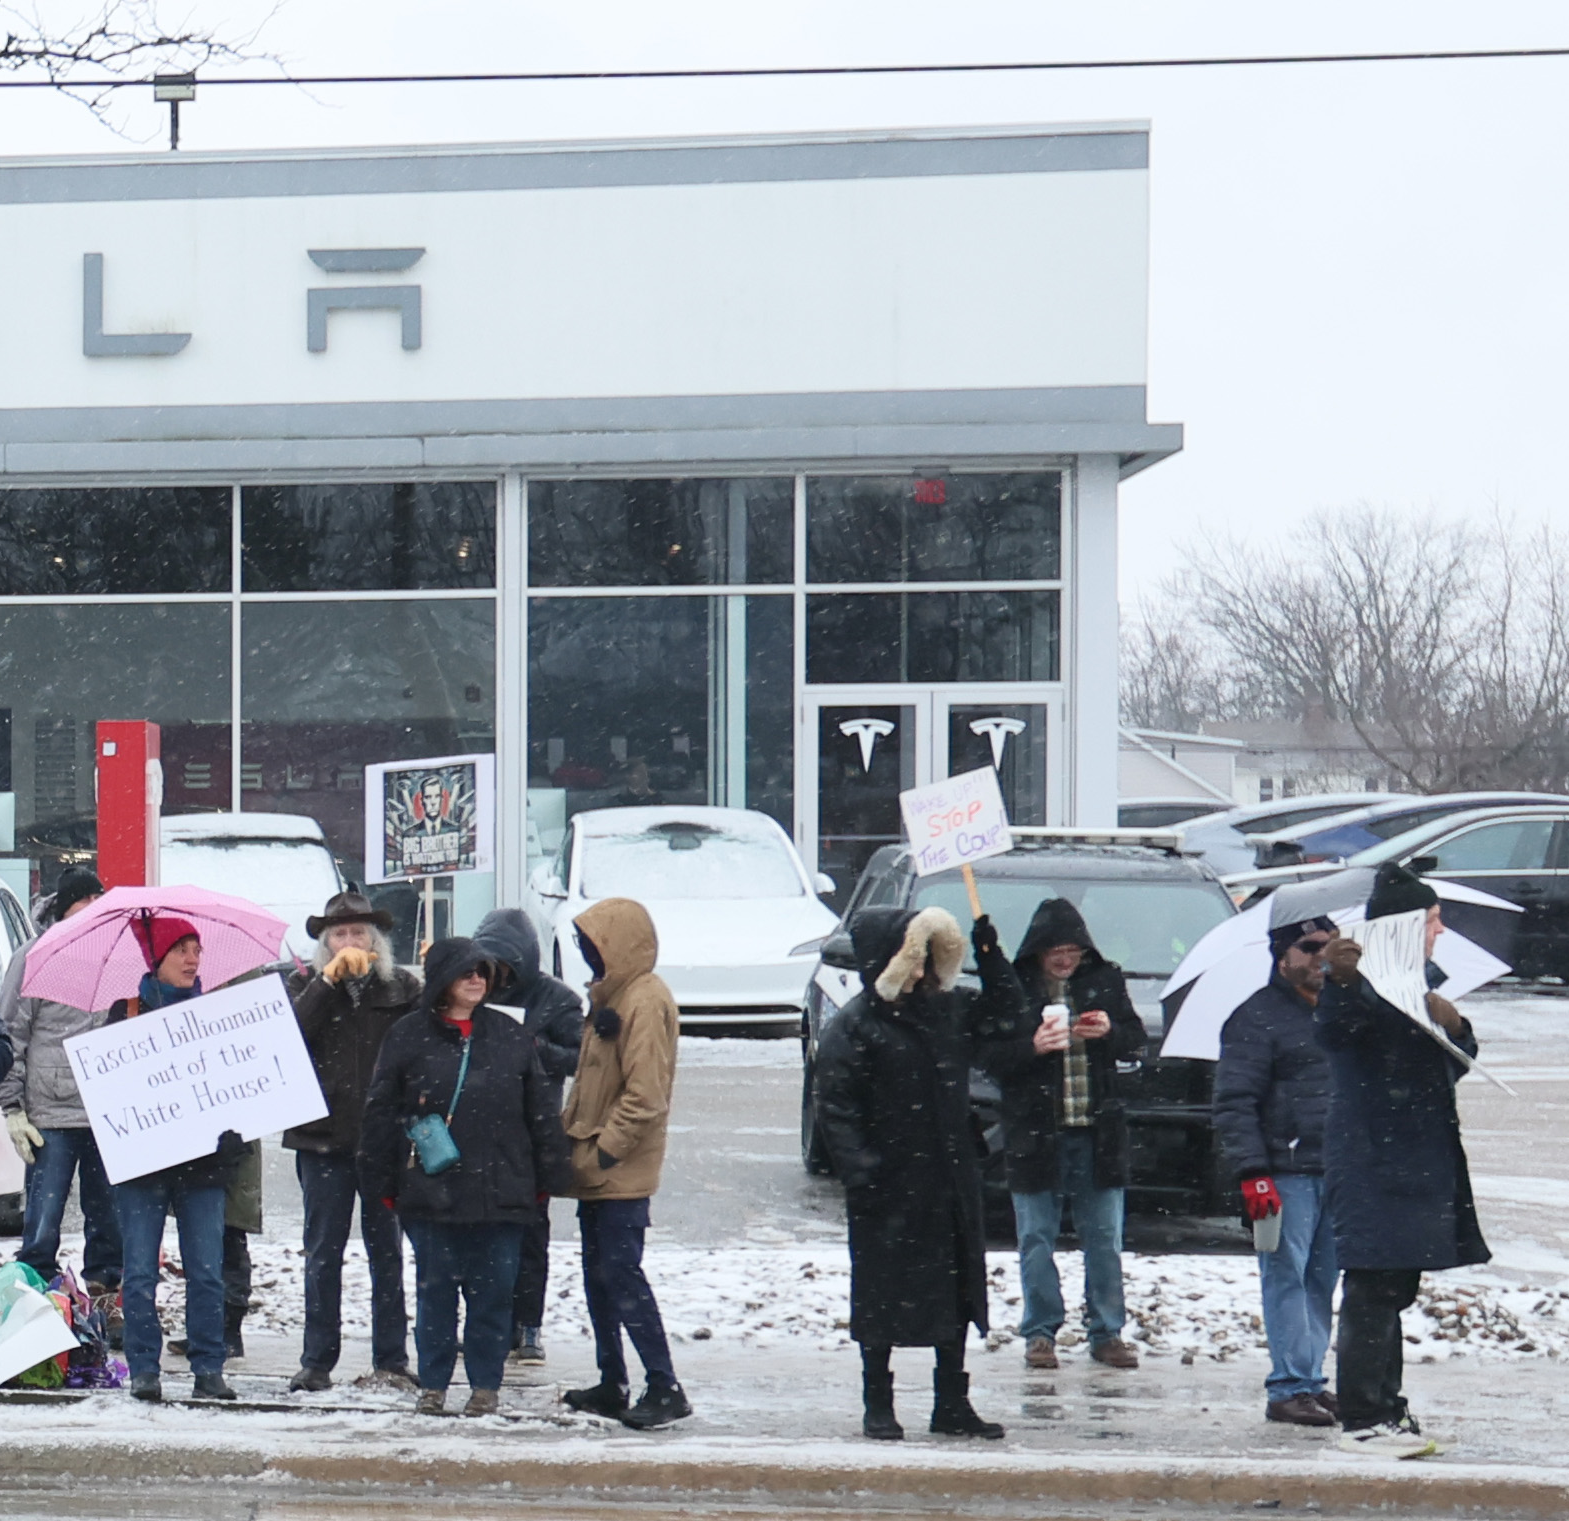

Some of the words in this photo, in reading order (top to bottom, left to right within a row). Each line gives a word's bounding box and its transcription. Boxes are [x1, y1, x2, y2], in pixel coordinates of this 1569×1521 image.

[927, 800, 982, 838] STOP
[402, 837, 420, 854] BIG
[421, 832, 459, 853] BROTHER
[918, 844, 950, 869] THE
[75, 1030, 162, 1083] Fascist
[162, 998, 287, 1049] billionnaire
[146, 1064, 184, 1090] out
[186, 1050, 209, 1076] of
[218, 1042, 259, 1068] the
[102, 1100, 184, 1140] White
